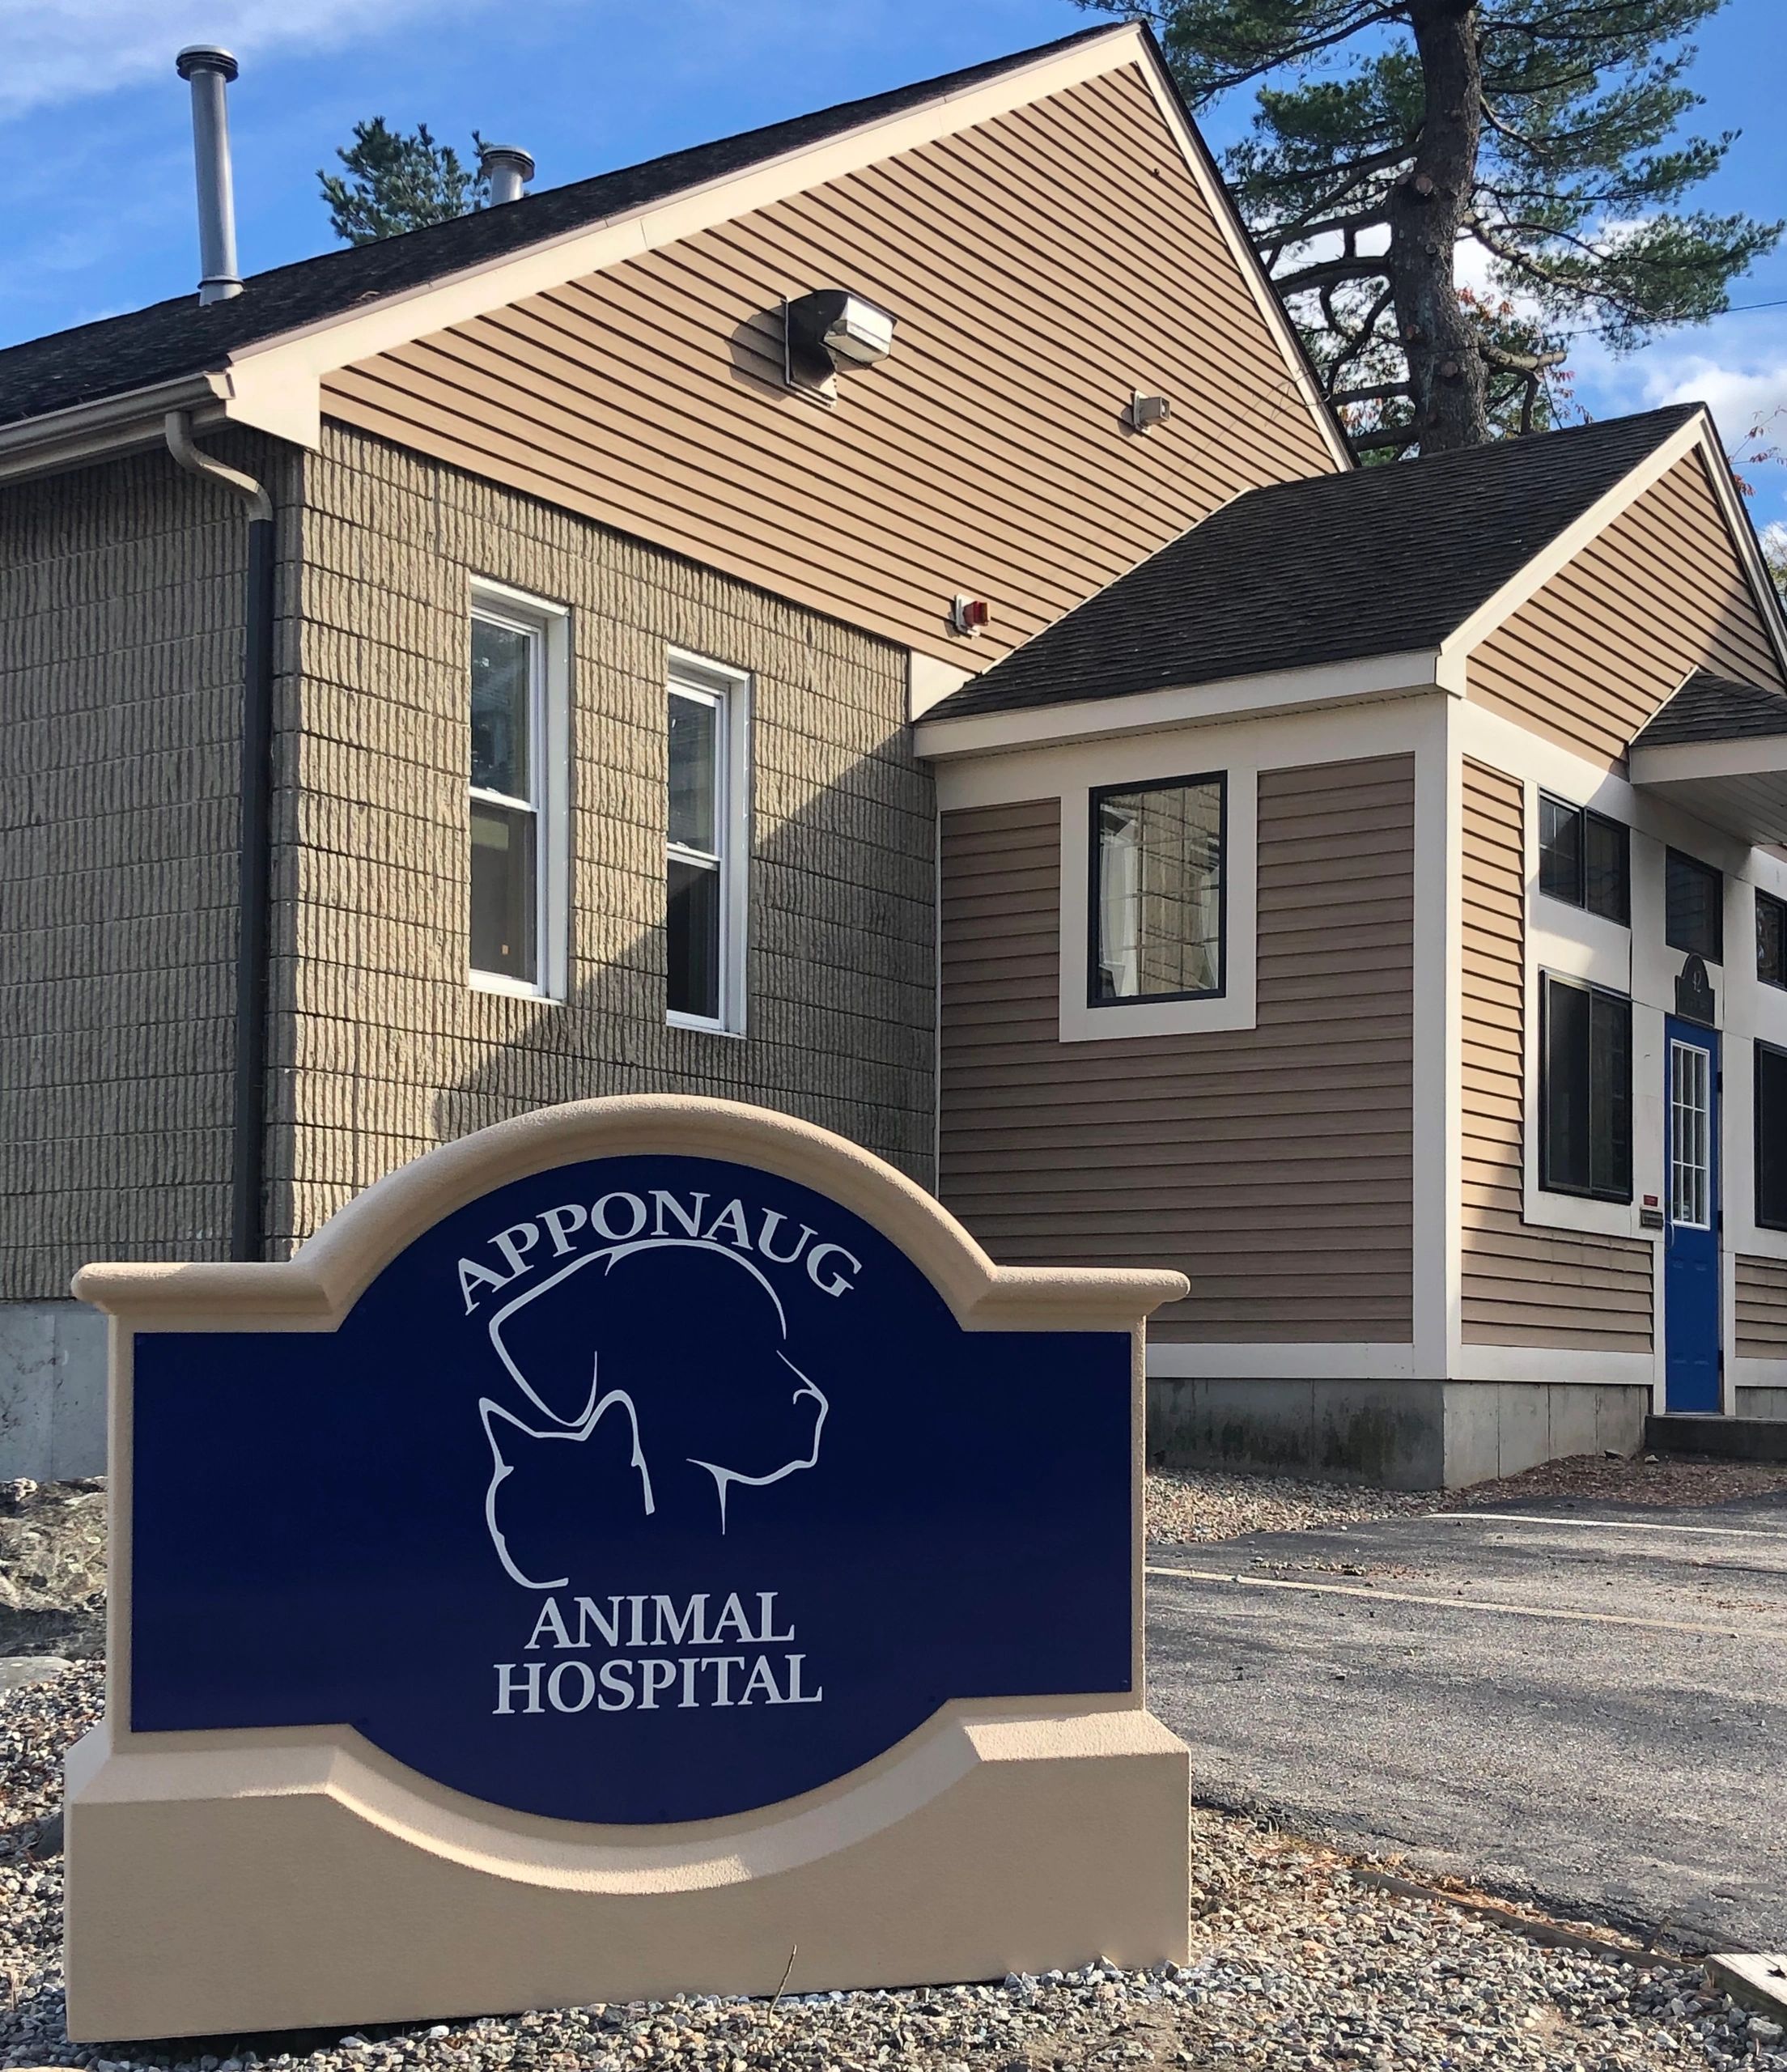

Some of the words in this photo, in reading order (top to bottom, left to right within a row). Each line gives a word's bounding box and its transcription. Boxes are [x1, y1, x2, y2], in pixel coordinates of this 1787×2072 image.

[457, 1191, 863, 1316] APPONAUG
[524, 1591, 796, 1650] ANIMAL
[491, 1654, 823, 1715] HOSPITAL
